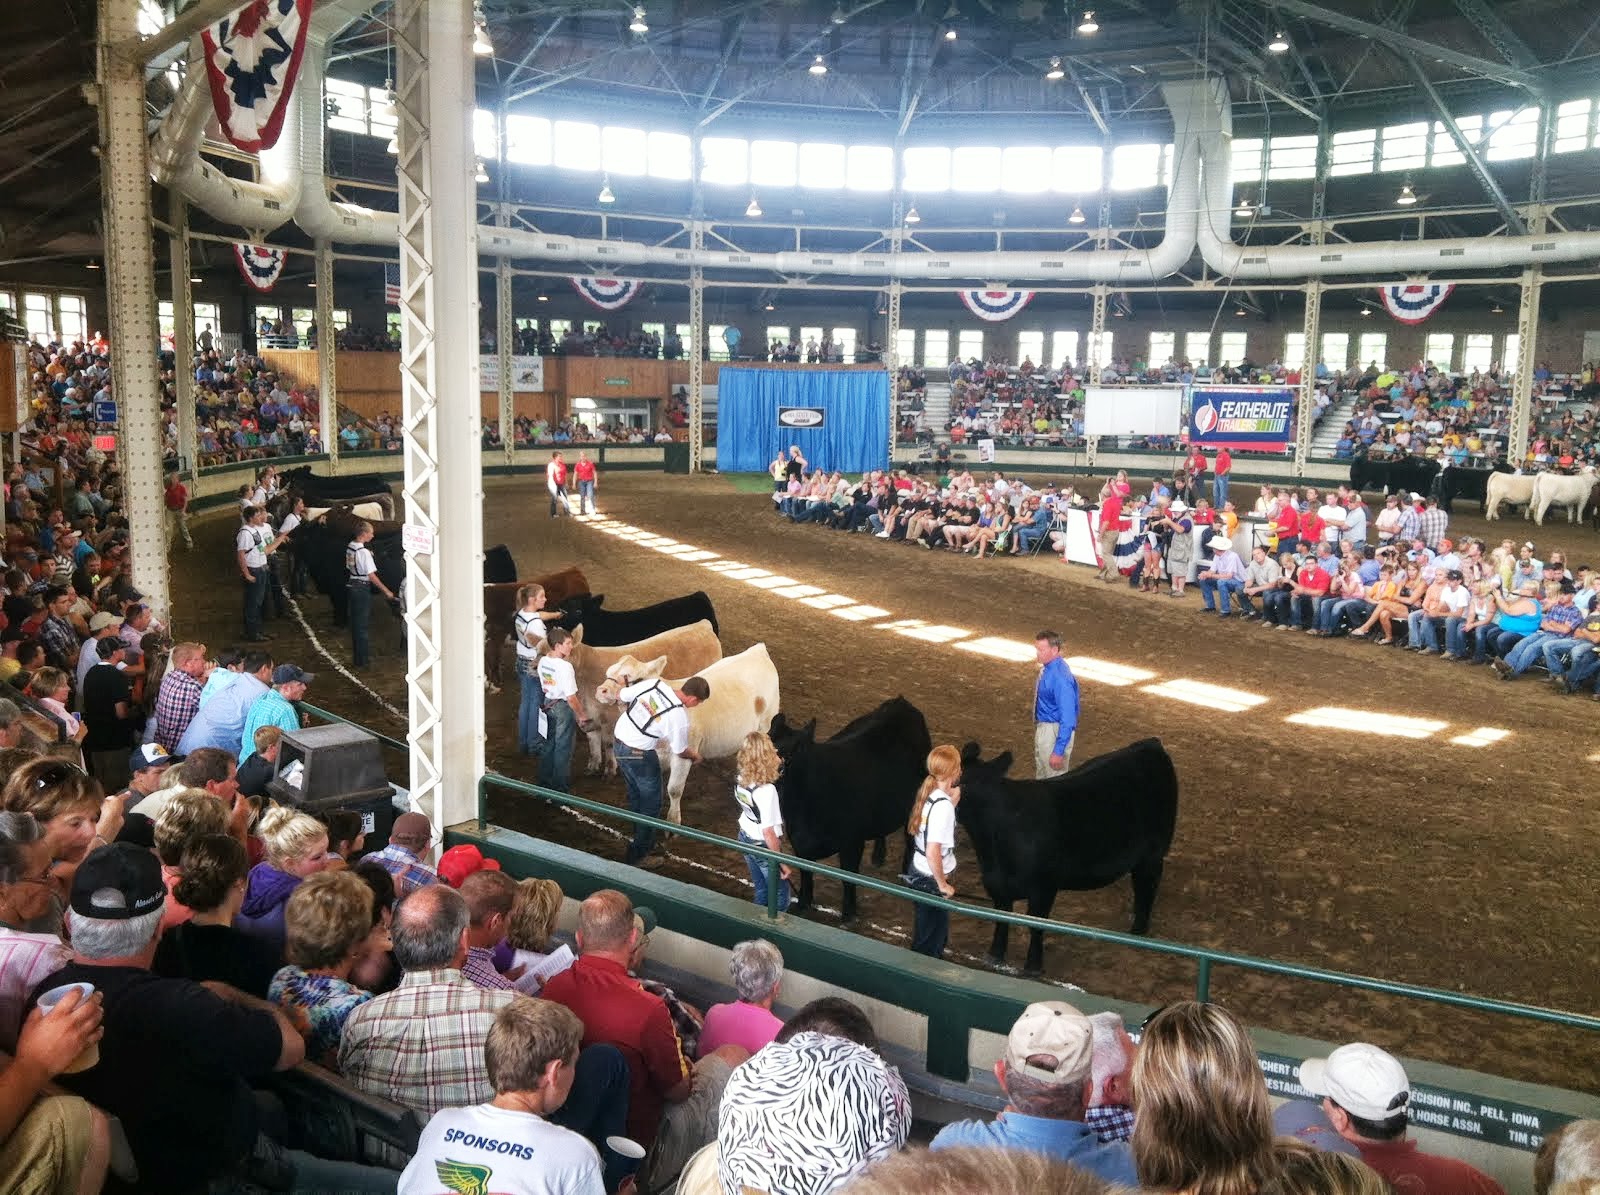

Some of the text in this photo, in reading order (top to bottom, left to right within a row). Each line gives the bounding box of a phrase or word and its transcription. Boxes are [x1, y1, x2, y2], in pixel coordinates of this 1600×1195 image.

[1219, 401, 1290, 418] FEATHERLITE
[1218, 419, 1257, 431] TRAILERS
[1416, 1109, 1450, 1128] HORSE
[1451, 1116, 1484, 1135] ASSN.
[1511, 1112, 1540, 1129] IOWA
[443, 1127, 535, 1161] SPONSORS
[1508, 1129, 1529, 1145] TIM
